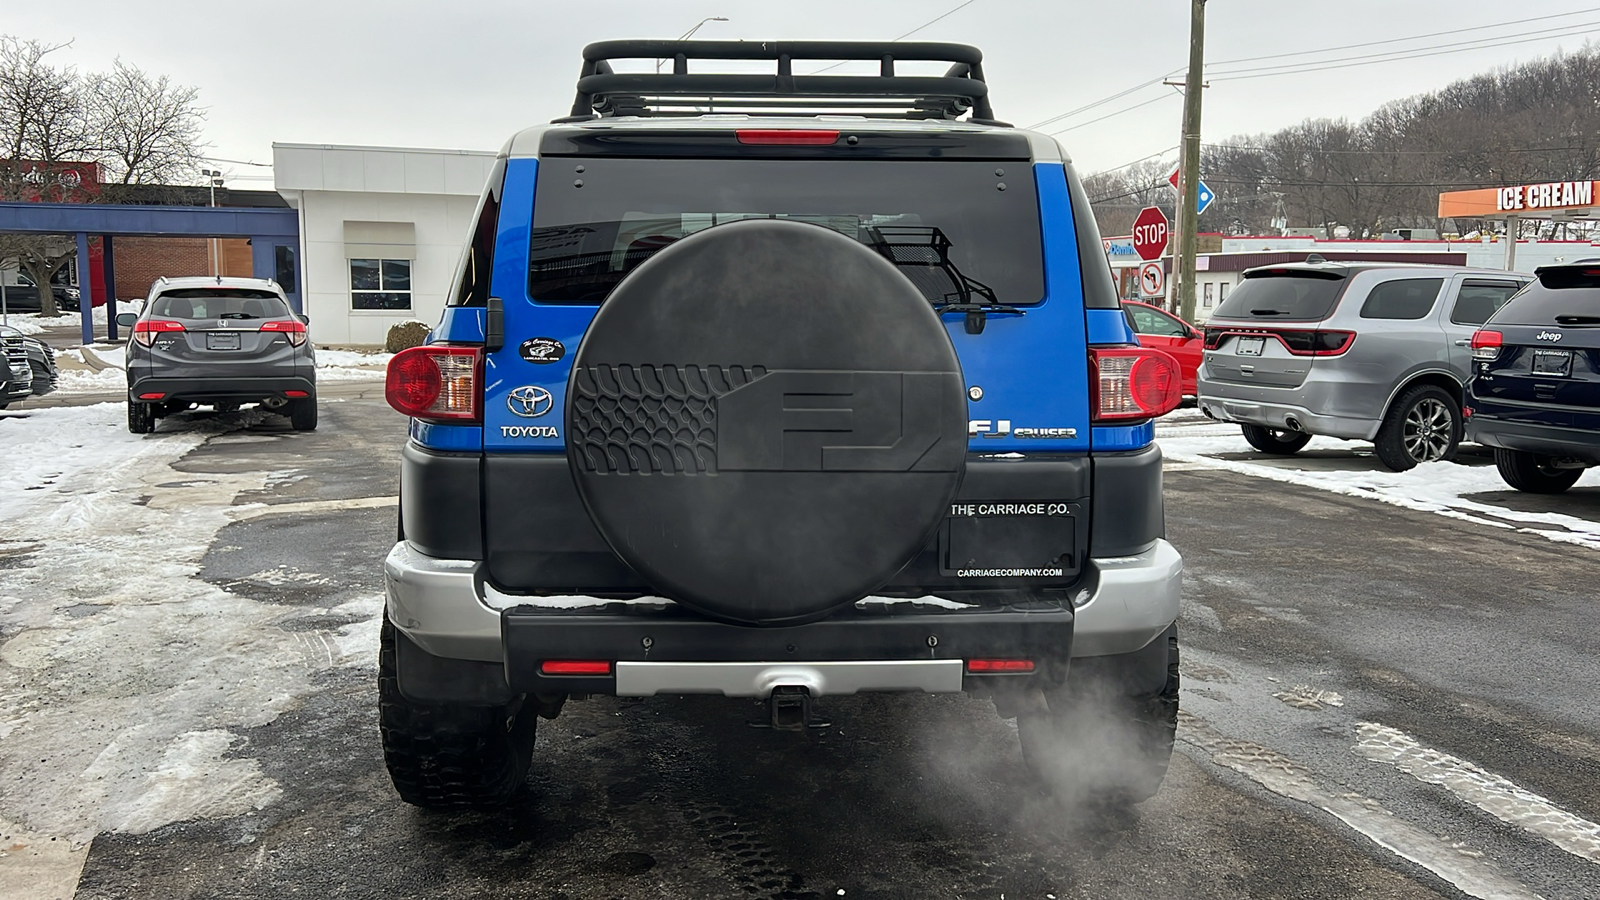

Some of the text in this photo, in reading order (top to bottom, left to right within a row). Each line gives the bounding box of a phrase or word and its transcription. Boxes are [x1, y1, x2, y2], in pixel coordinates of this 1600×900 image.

[1497, 180, 1593, 211] ICE CREAM
[1135, 222, 1166, 246] STOP
[1536, 330, 1562, 342] Jeep
[500, 426, 559, 438] TOYOTA
[968, 420, 1078, 439] FJ CRUISER
[951, 503, 1070, 516] THE CARRIAGE CO.
[957, 568, 1063, 578] CARRIAGECOMPANY.COM
